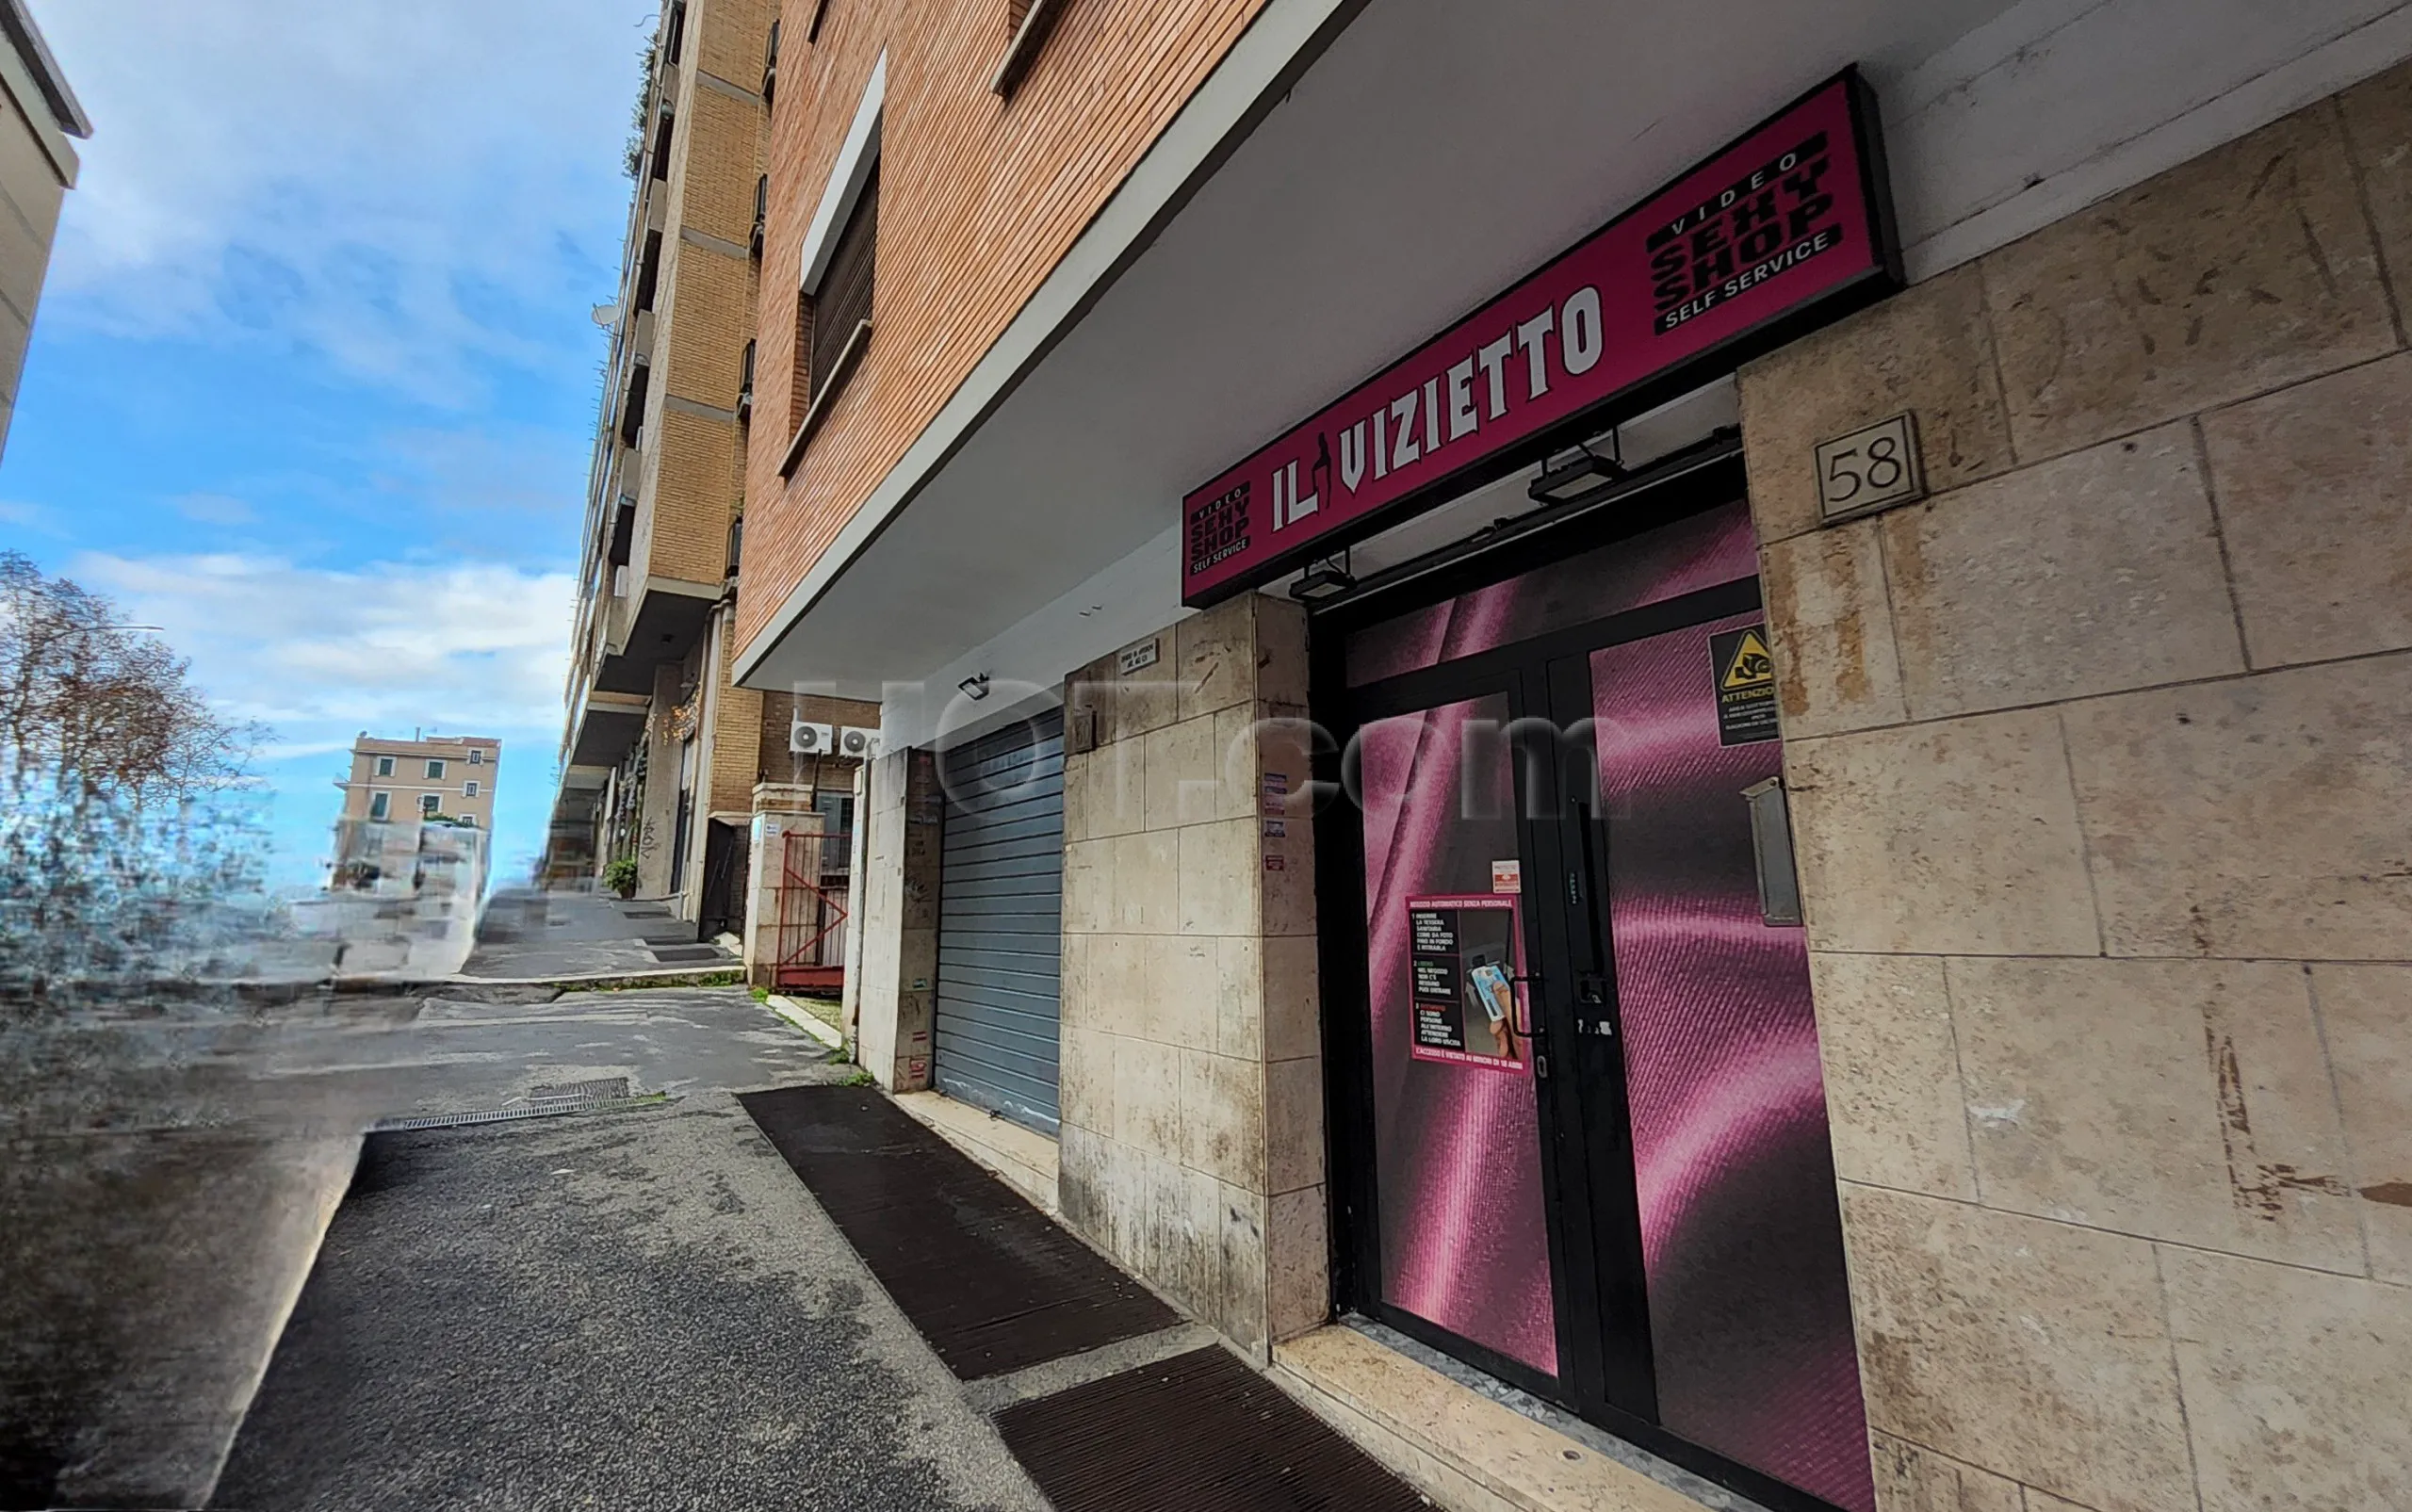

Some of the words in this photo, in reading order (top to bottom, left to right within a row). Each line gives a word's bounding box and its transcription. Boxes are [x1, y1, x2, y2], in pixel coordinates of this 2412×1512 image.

[1671, 153, 1797, 235] VIDEO
[1654, 193, 1833, 311] SHOP
[1665, 291, 1717, 329] SELF
[1724, 232, 1829, 298] SERVICE
[1272, 460, 1318, 533] IL
[1339, 285, 1605, 496] VIZIETTO
[1829, 437, 1901, 502] 58
[1199, 488, 1241, 518] VIDEO
[1191, 516, 1249, 561] SHOP
[1194, 558, 1211, 573] SELF
[1213, 539, 1247, 563] SERVICE
[1722, 687, 1775, 703] ATTENZIO
